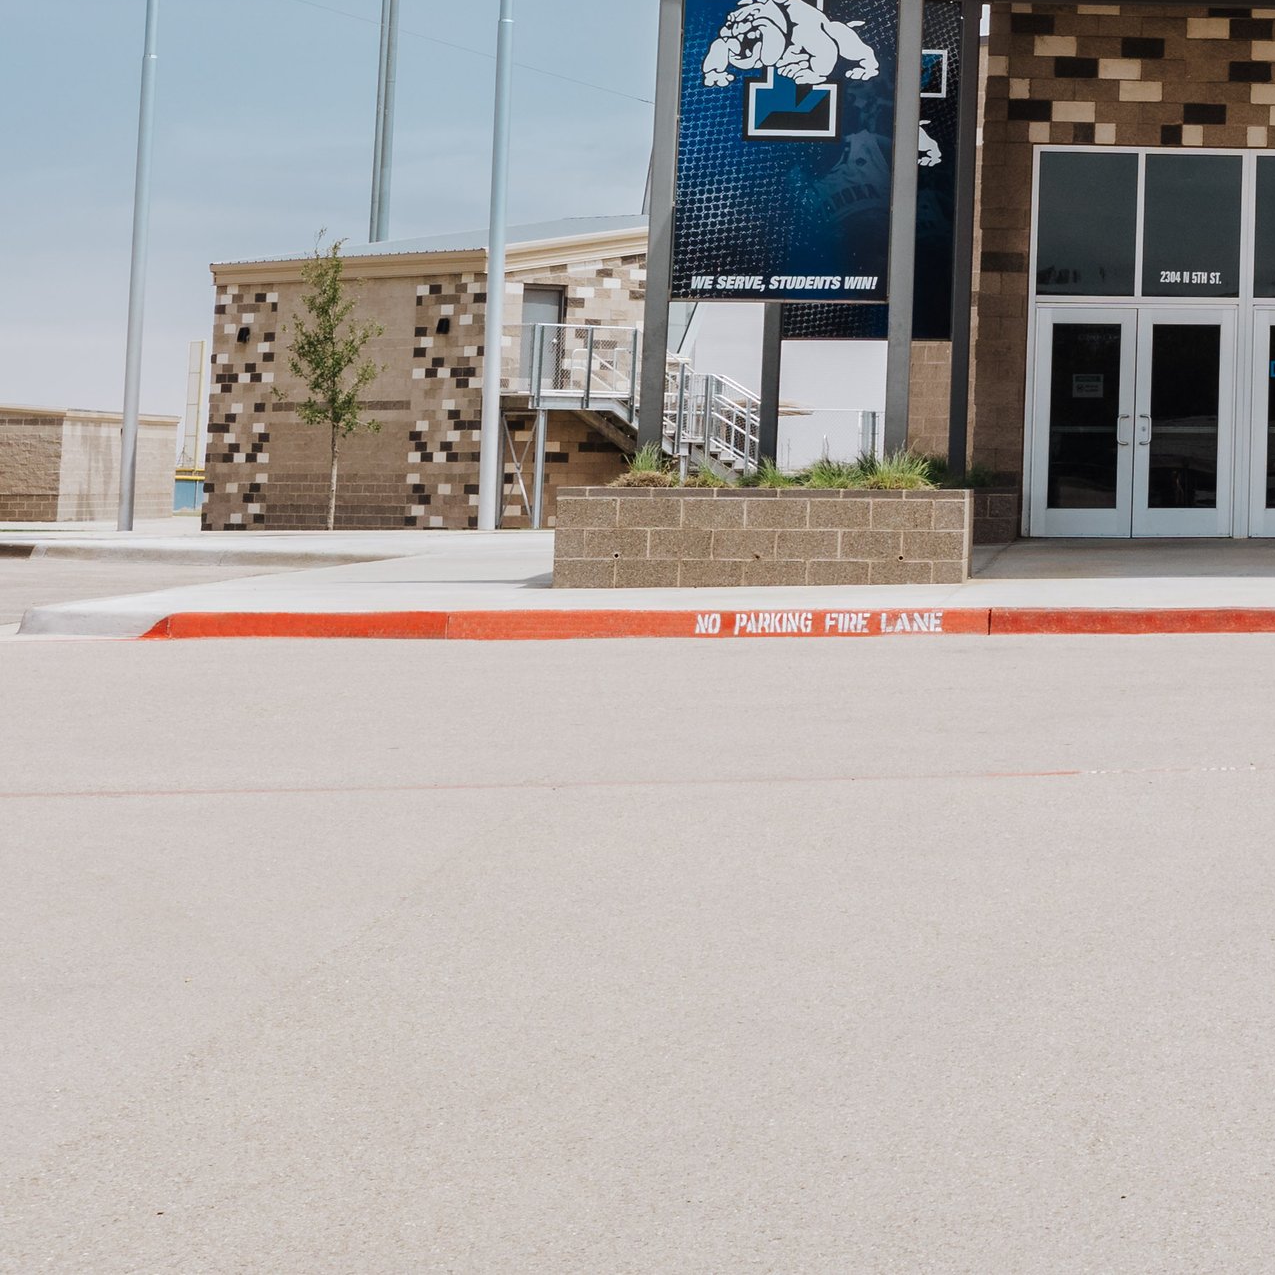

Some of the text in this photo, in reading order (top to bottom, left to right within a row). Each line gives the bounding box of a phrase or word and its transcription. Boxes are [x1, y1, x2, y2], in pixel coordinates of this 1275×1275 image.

[690, 275, 878, 292] WE SERVE, STUDENTS WIN!
[1160, 270, 1222, 285] 2304 N 5TH ST.
[694, 611, 943, 635] NO PARKING FIRE LANE
